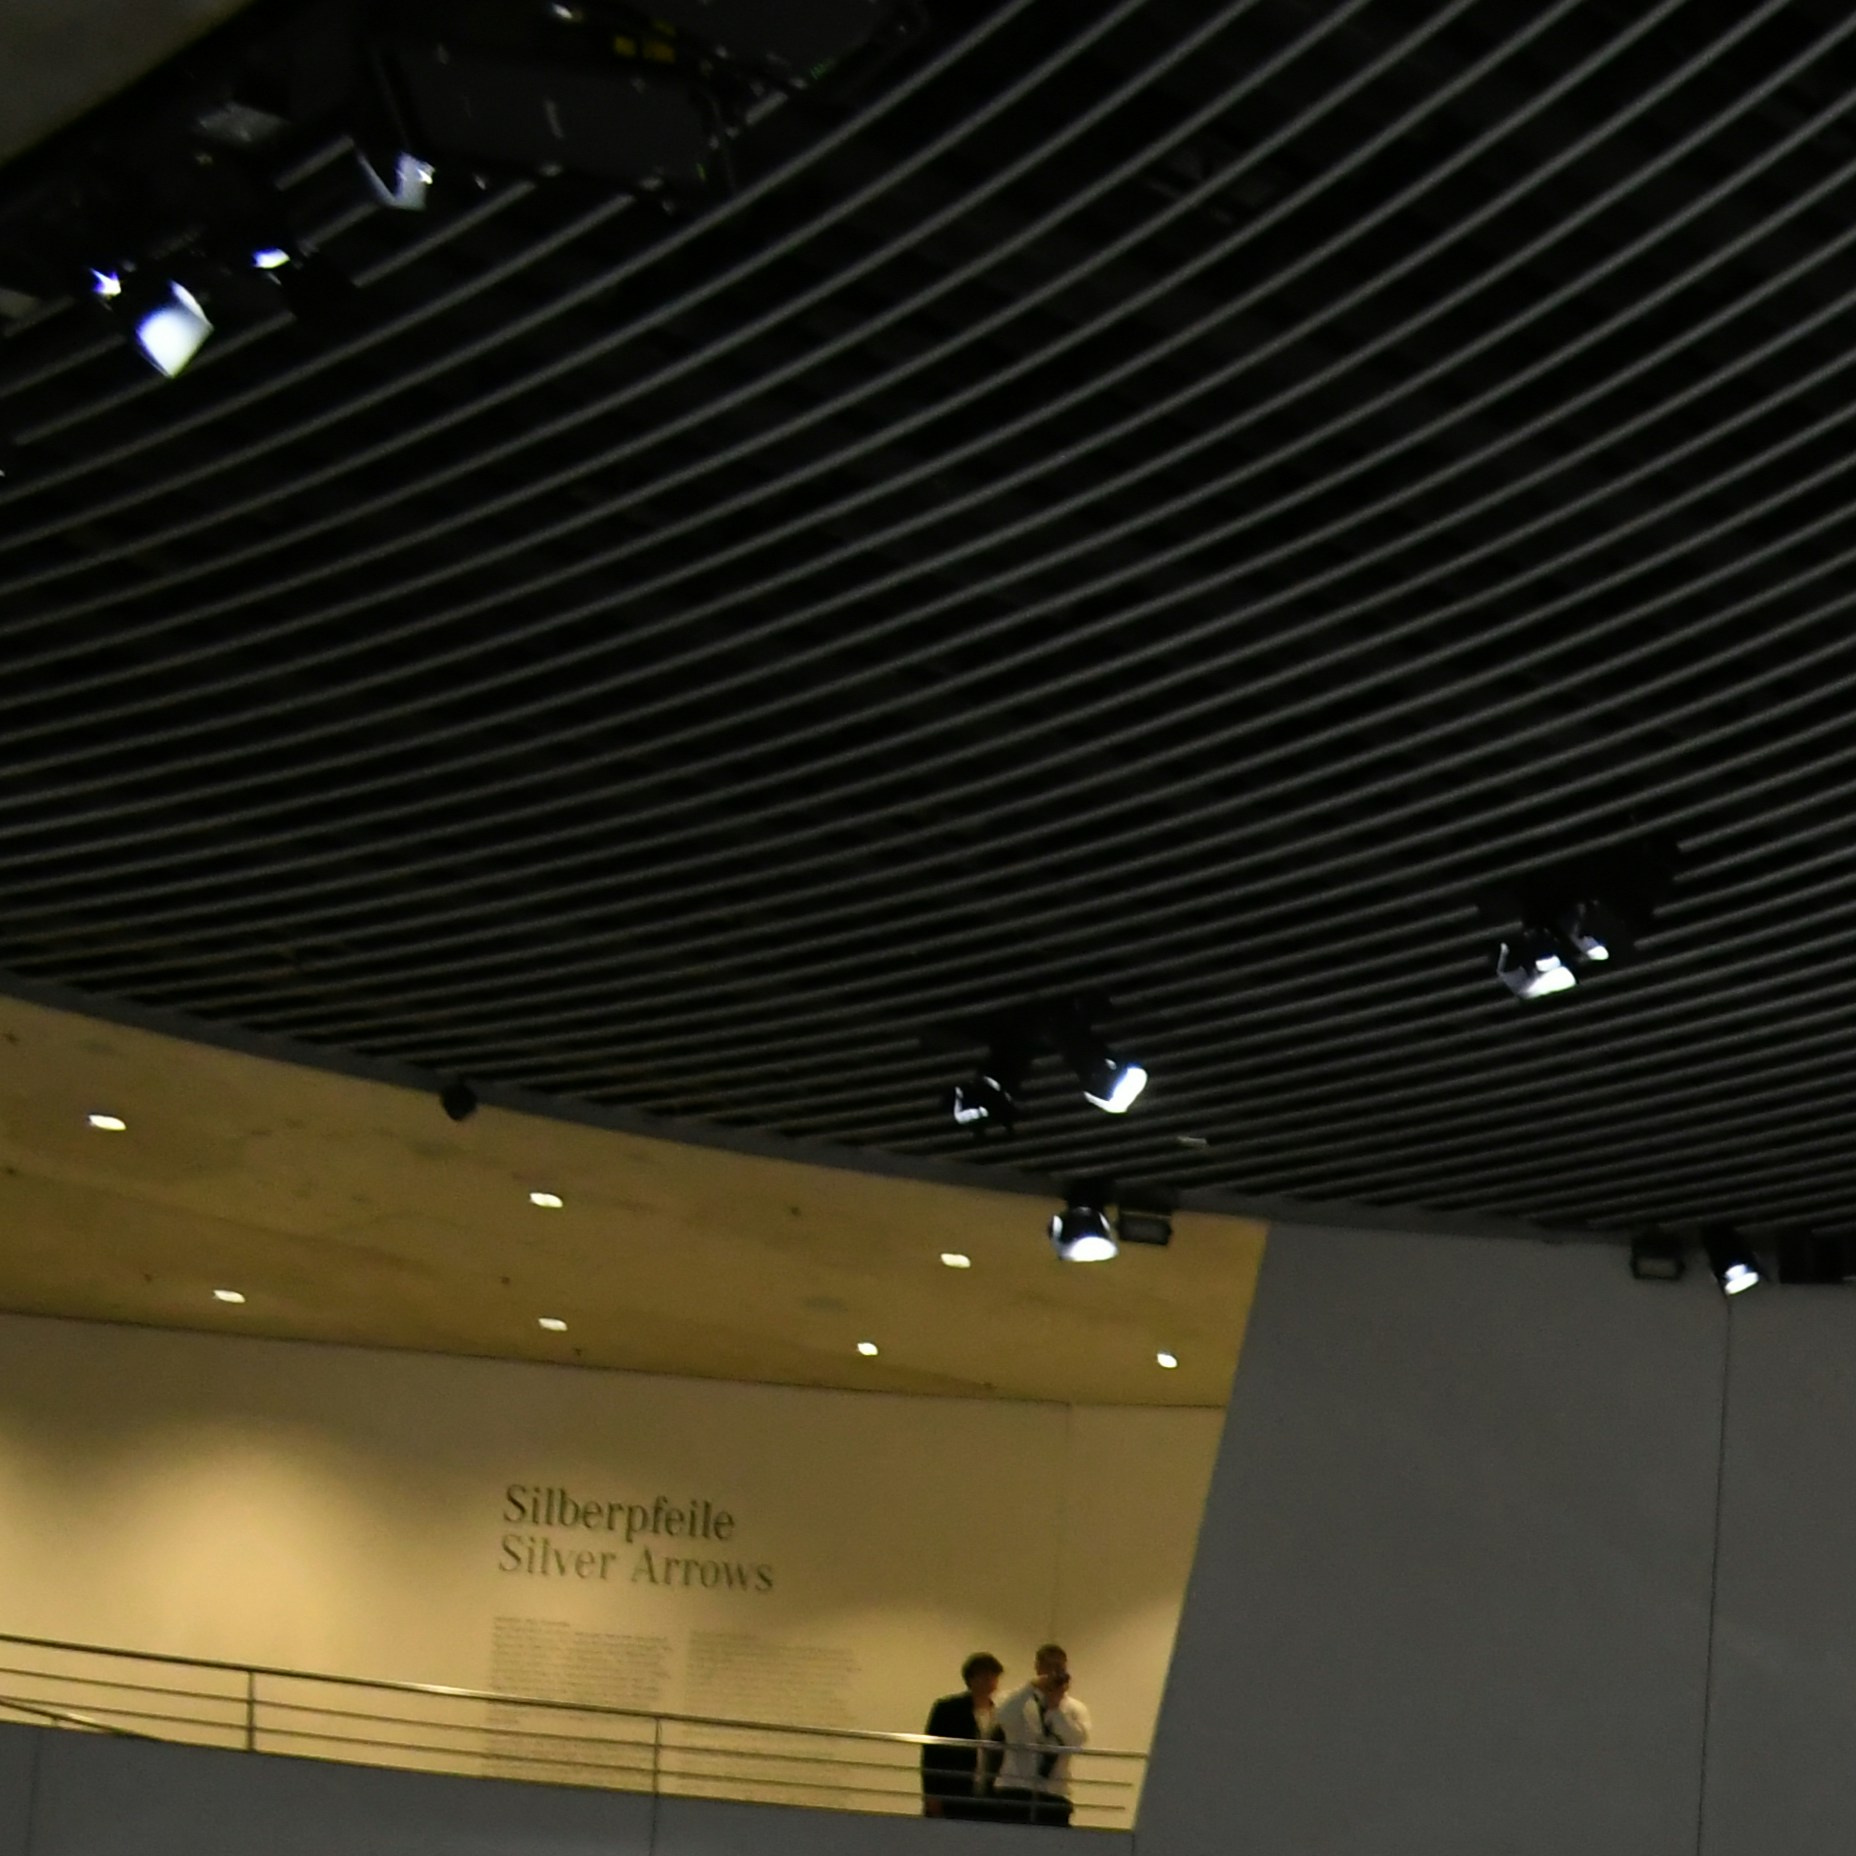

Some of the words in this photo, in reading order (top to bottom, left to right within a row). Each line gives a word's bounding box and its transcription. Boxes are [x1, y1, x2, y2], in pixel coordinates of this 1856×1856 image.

[502, 1483, 736, 1543] Silberpfeile
[498, 1534, 617, 1581] Silver
[630, 1546, 775, 1593] Arrows
